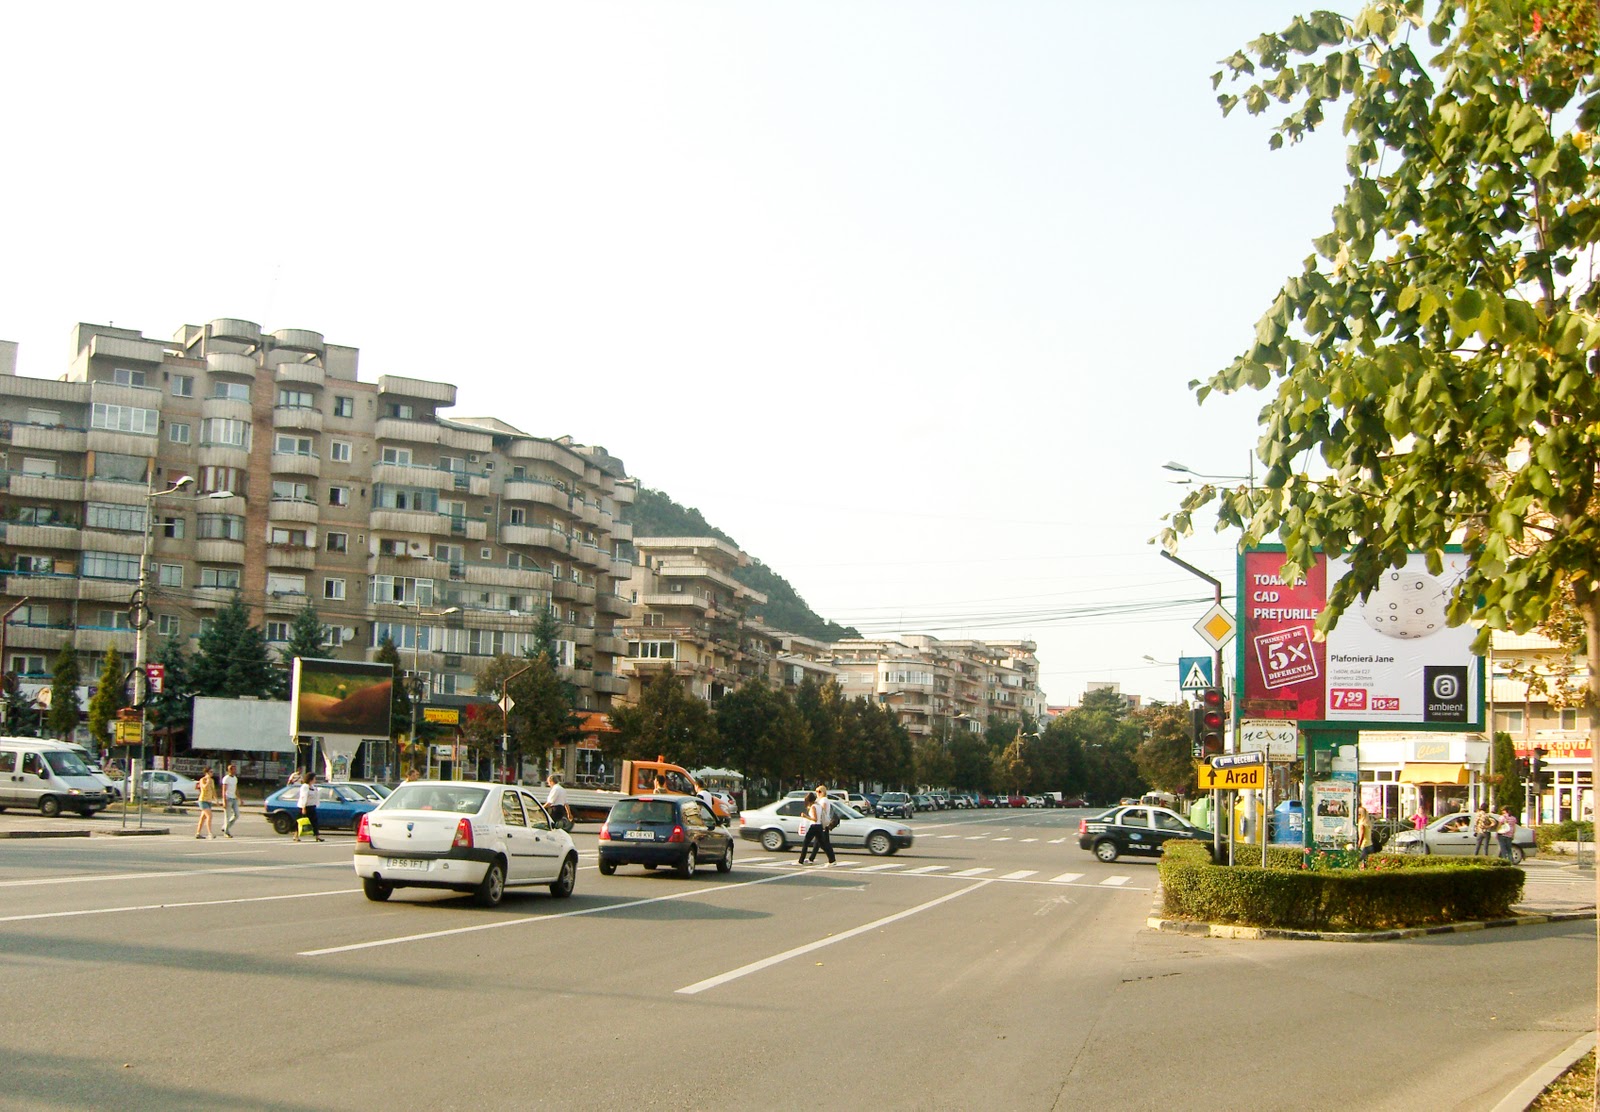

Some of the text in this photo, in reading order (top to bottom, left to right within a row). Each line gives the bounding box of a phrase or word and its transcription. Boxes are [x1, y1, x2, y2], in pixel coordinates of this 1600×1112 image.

[1253, 574, 1307, 586] TOAMA
[1253, 591, 1279, 602] CAD
[1374, 655, 1394, 663] Jane
[1333, 691, 1363, 708] 7,99
[1225, 769, 1257, 784] Arad
[410, 860, 423, 868] TFT
